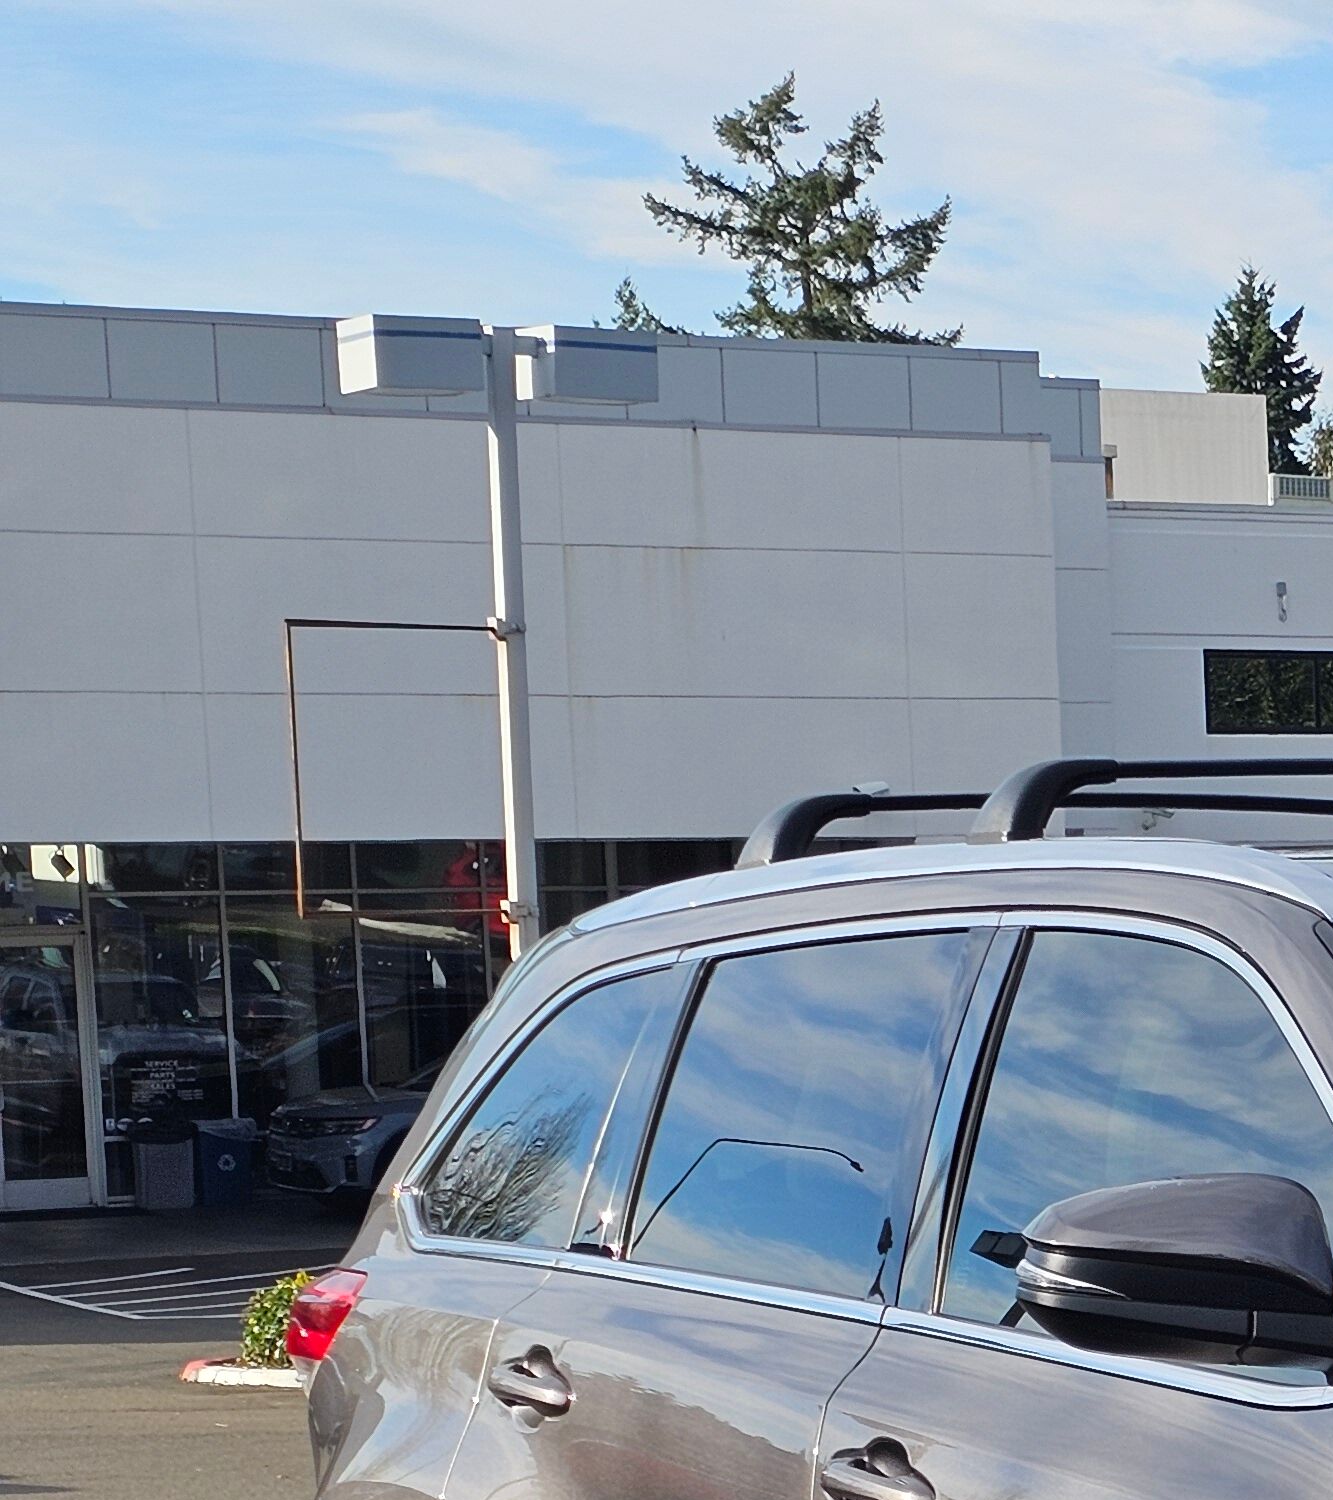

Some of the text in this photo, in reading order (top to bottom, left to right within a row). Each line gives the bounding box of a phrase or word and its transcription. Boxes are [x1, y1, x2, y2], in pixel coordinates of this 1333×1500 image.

[145, 1060, 179, 1068] SERVICE
[149, 1072, 176, 1080] PARTS
[150, 1082, 176, 1090] SALES
